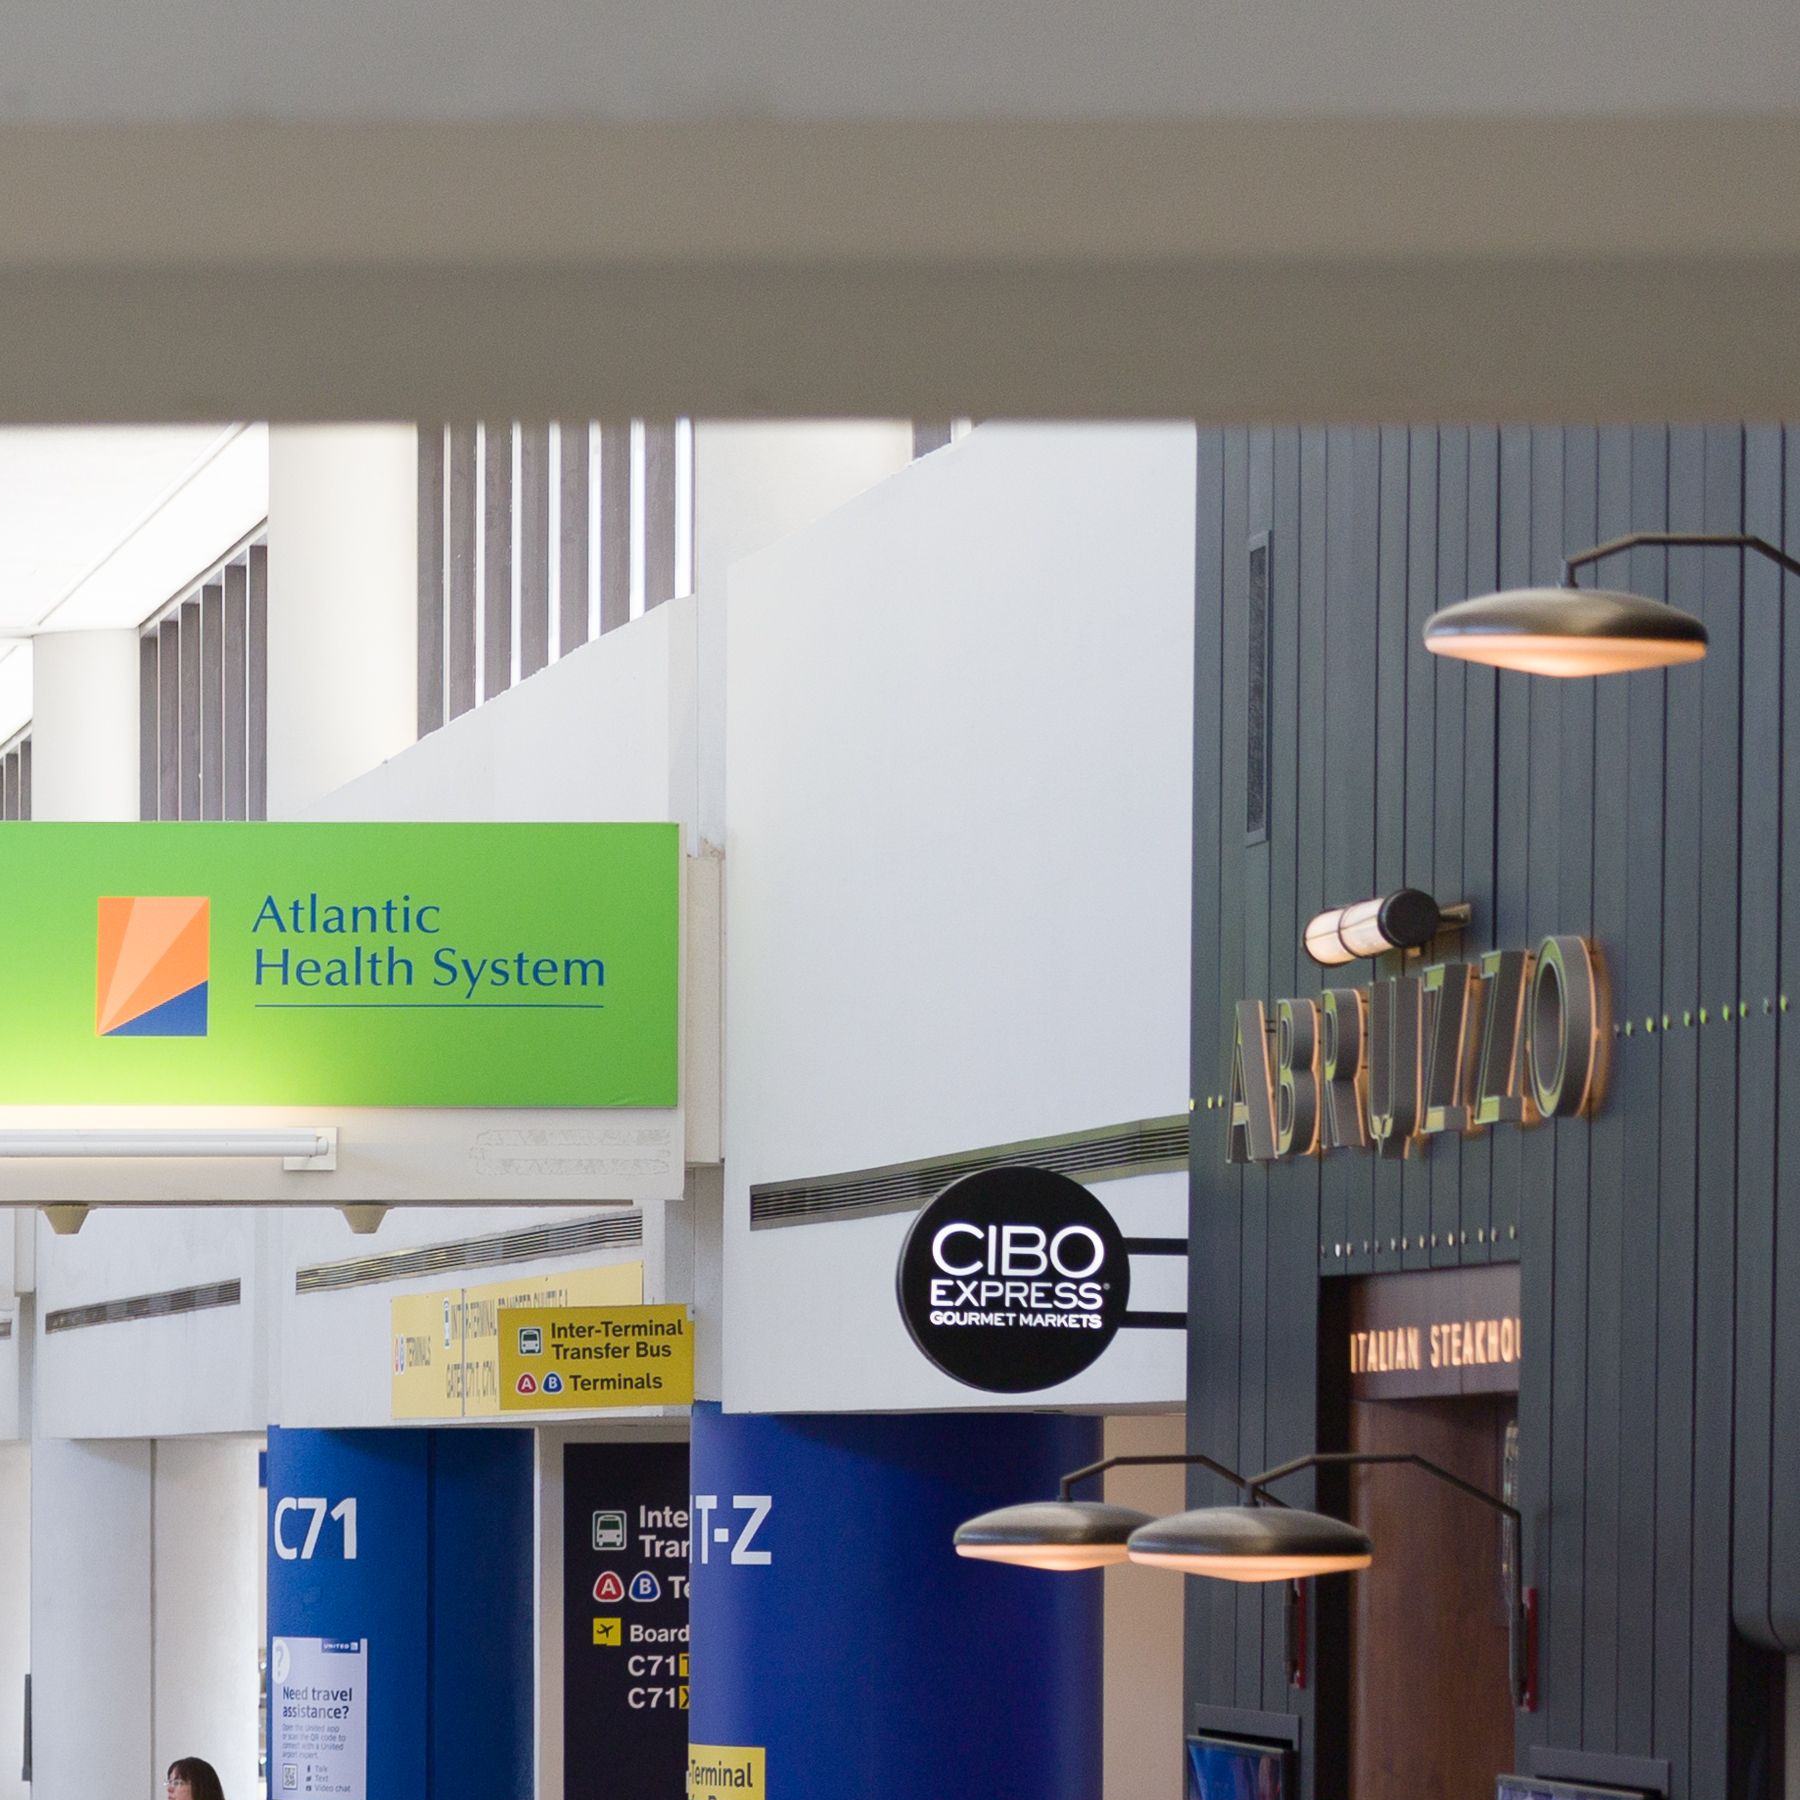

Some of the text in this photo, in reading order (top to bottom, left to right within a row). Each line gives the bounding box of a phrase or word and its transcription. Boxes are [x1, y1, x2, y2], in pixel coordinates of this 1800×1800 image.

[252, 894, 441, 934] Atlantic
[255, 947, 606, 998] Health System
[1225, 934, 1600, 1164] ABRUZZO
[931, 1222, 1105, 1279] CIBO
[930, 1279, 1104, 1309] EXPRESS
[551, 1319, 684, 1339] Inter-Terminal
[930, 1311, 1103, 1329] GOURMET MARKETS
[551, 1342, 672, 1360] Transfer Bus
[1350, 1326, 1421, 1374] ITALIAN
[521, 1373, 663, 1391] A B Terminals
[274, 1497, 358, 1561] C71
[689, 1495, 772, 1565] T-Z
[600, 1578, 617, 1595] A
[639, 1578, 652, 1595] B
[282, 1686, 353, 1702] Need travel
[282, 1705, 350, 1720] assistance?
[305, 1724, 325, 1732] United
[310, 1733, 319, 1741] QR
[320, 1733, 337, 1741] code
[338, 1734, 347, 1742] to
[321, 1743, 344, 1751] United
[314, 1765, 328, 1773] Talk
[314, 1774, 329, 1783] Text
[314, 1784, 351, 1793] Video chat
